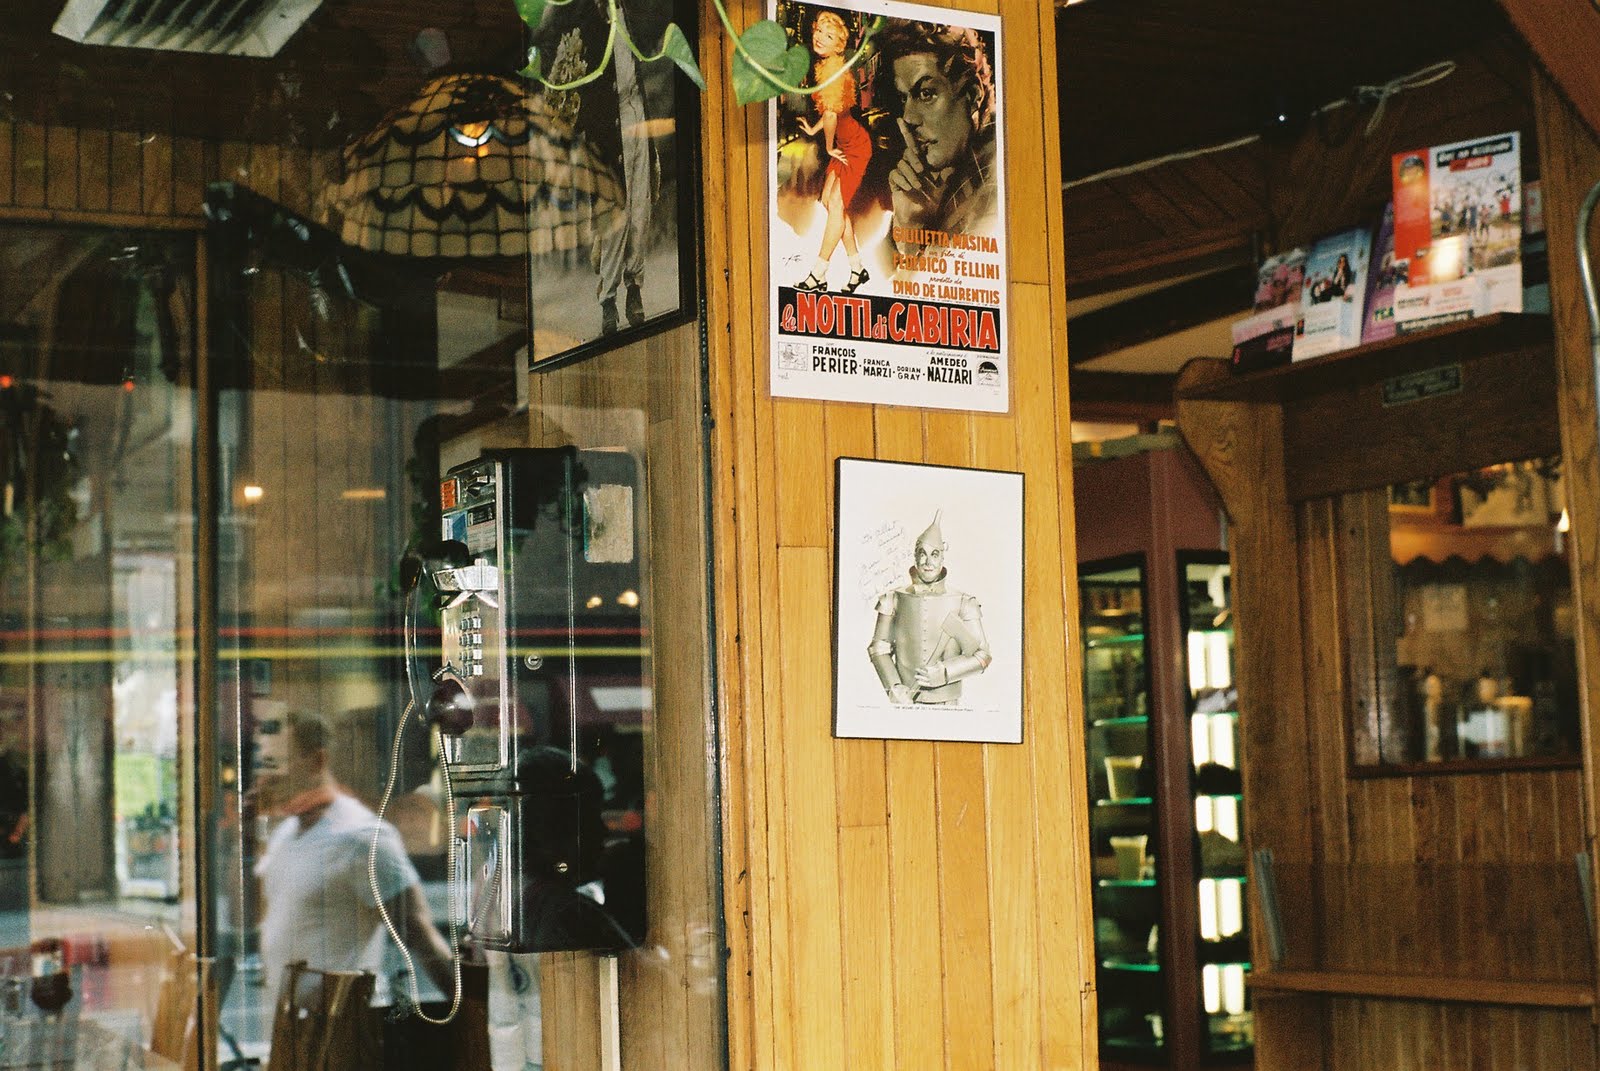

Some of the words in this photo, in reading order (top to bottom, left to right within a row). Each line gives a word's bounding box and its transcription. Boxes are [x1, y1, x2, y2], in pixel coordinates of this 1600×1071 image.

[893, 226, 950, 248] GIULIETTA
[952, 233, 998, 254] MASINA
[892, 253, 947, 274] FEDERICO
[954, 260, 1000, 280] FELLINI
[893, 280, 920, 296] DINO
[923, 283, 936, 298] DE
[938, 284, 1000, 304] LAURENTIIS
[781, 303, 797, 332] le
[796, 292, 872, 339] NOTTI
[872, 313, 888, 340] di
[888, 302, 999, 351] CABIRIA
[812, 345, 856, 358] FRANÇOIS
[812, 356, 858, 375] PERIER
[863, 359, 890, 367] FRANCA
[930, 357, 967, 368] AMEDEO
[863, 366, 892, 379] MARZI
[898, 372, 921, 380] GRAY
[927, 366, 972, 385] NAZZARI
